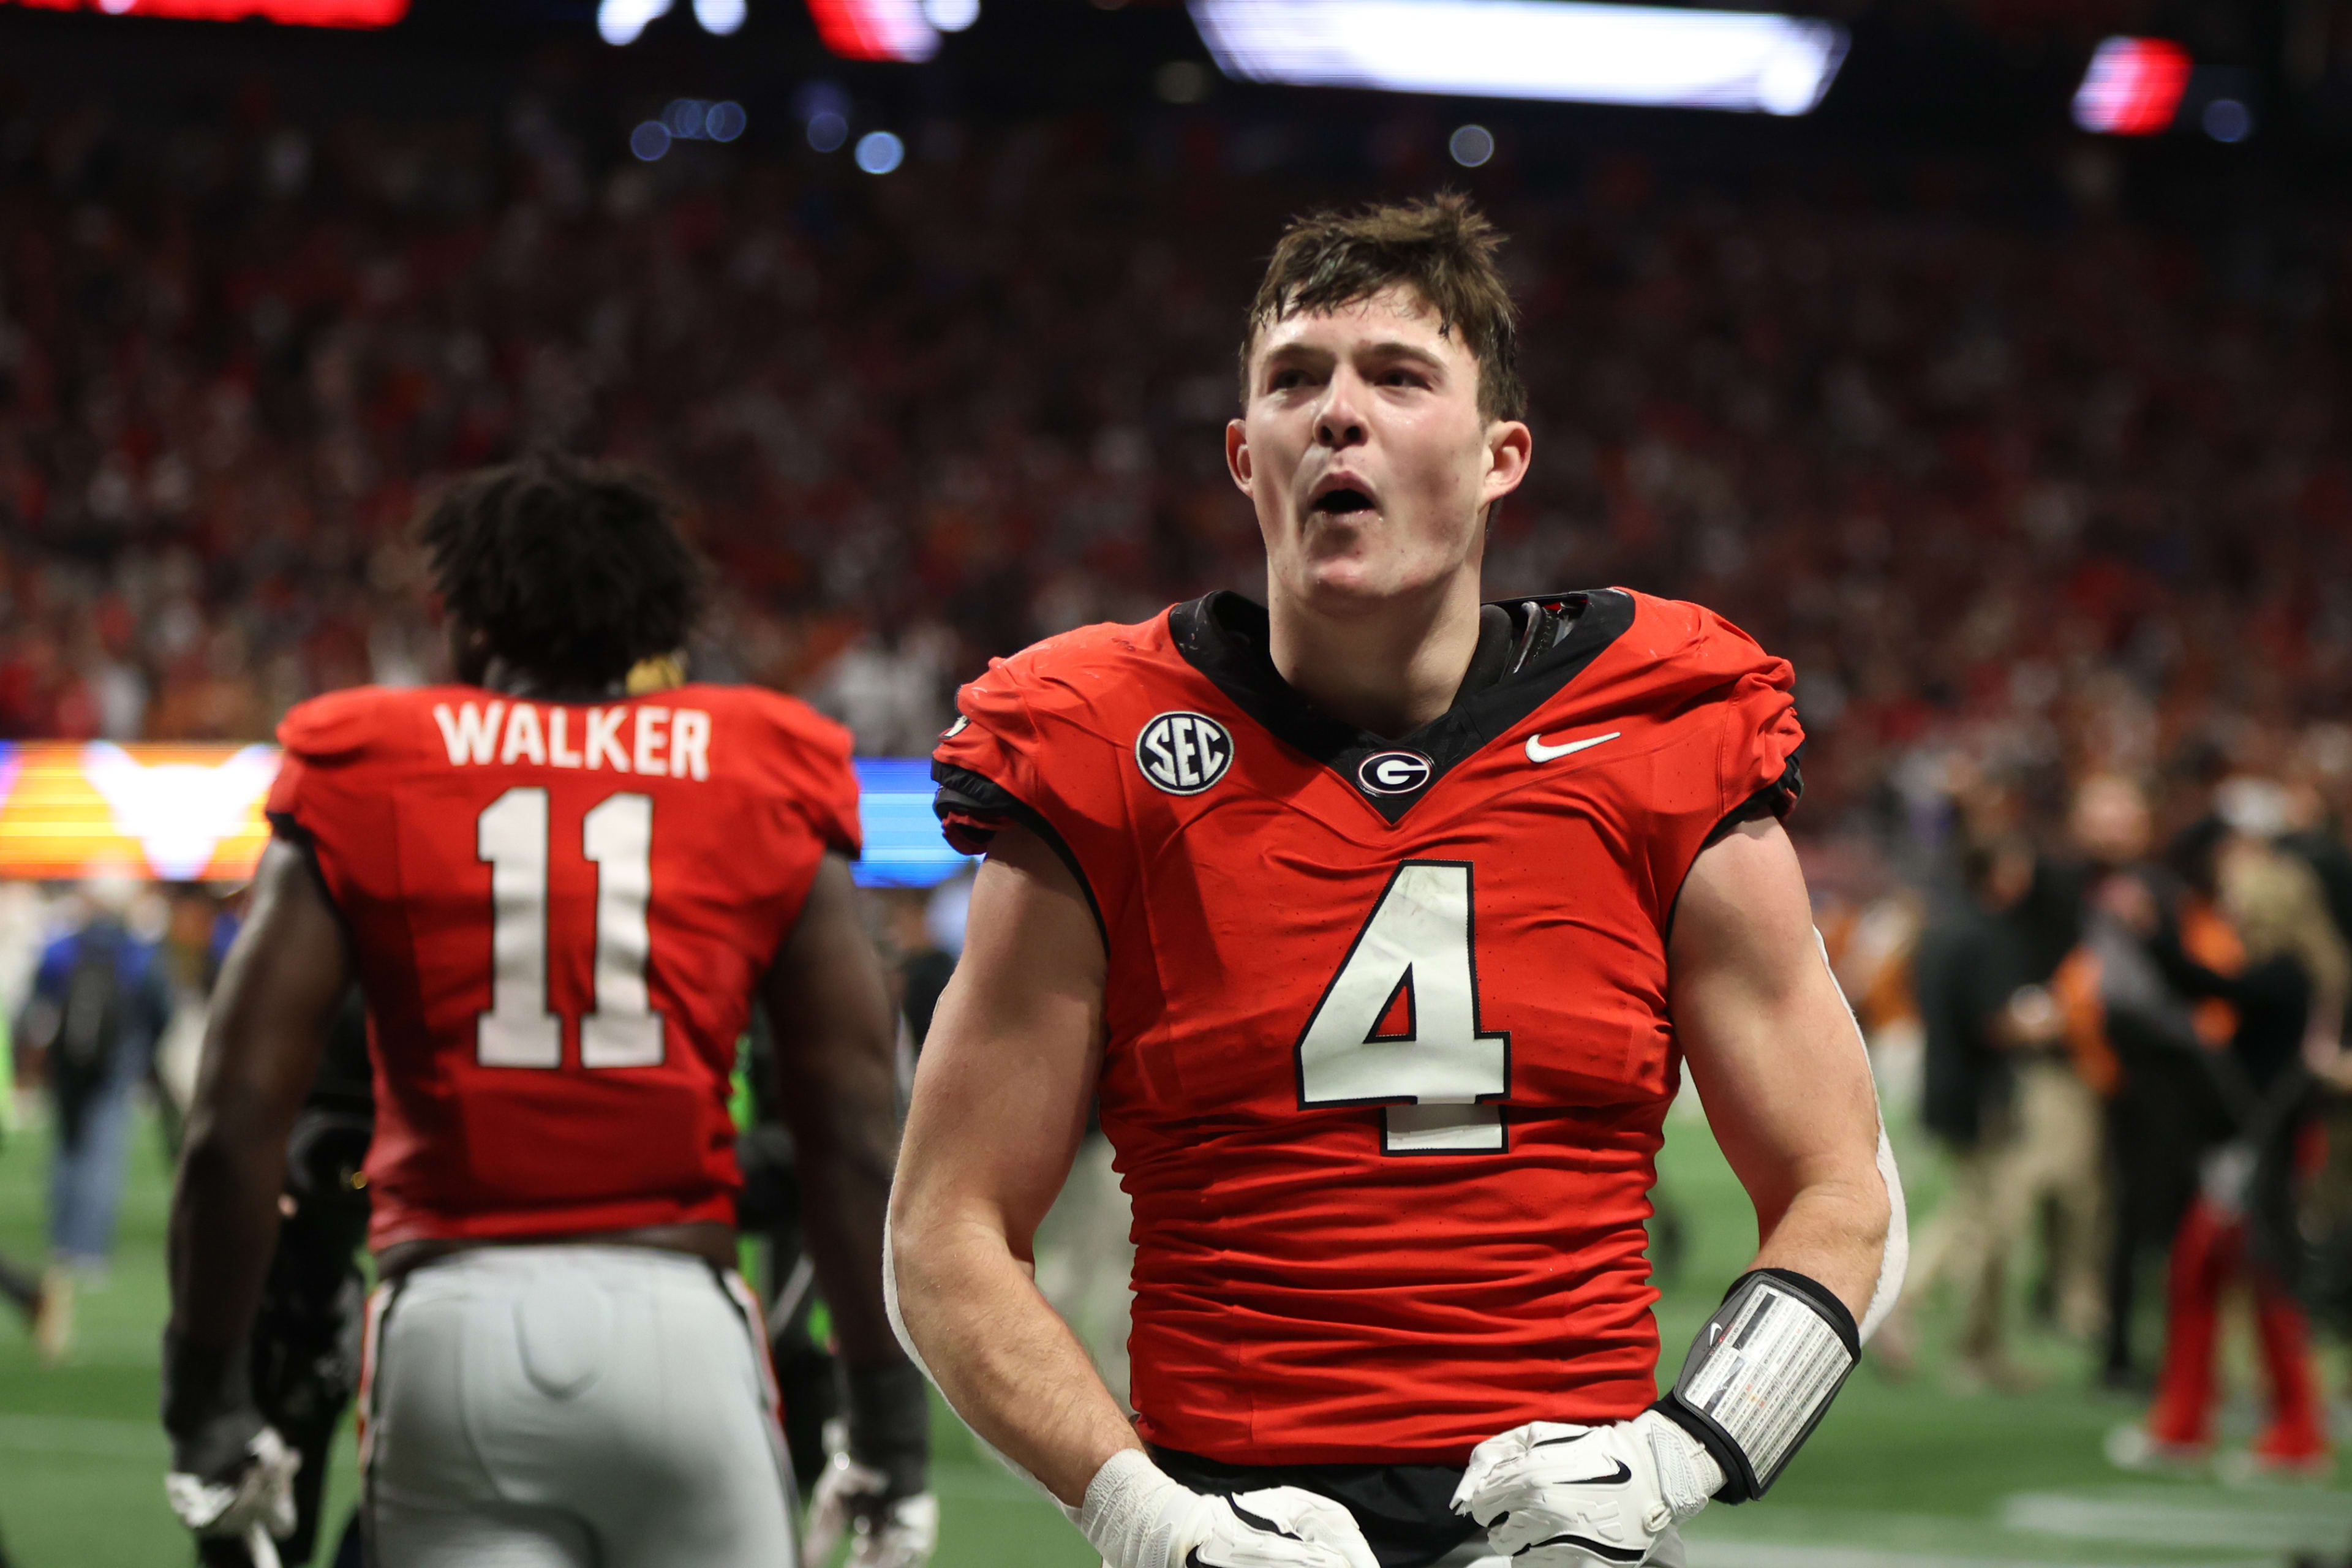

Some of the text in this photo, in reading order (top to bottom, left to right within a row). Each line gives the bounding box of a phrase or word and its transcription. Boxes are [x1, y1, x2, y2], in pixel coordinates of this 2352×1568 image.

[434, 702, 711, 781] WALKER
[1146, 718, 1224, 785] SEC
[477, 786, 665, 1069] 11
[1295, 859, 1510, 1155] 4
